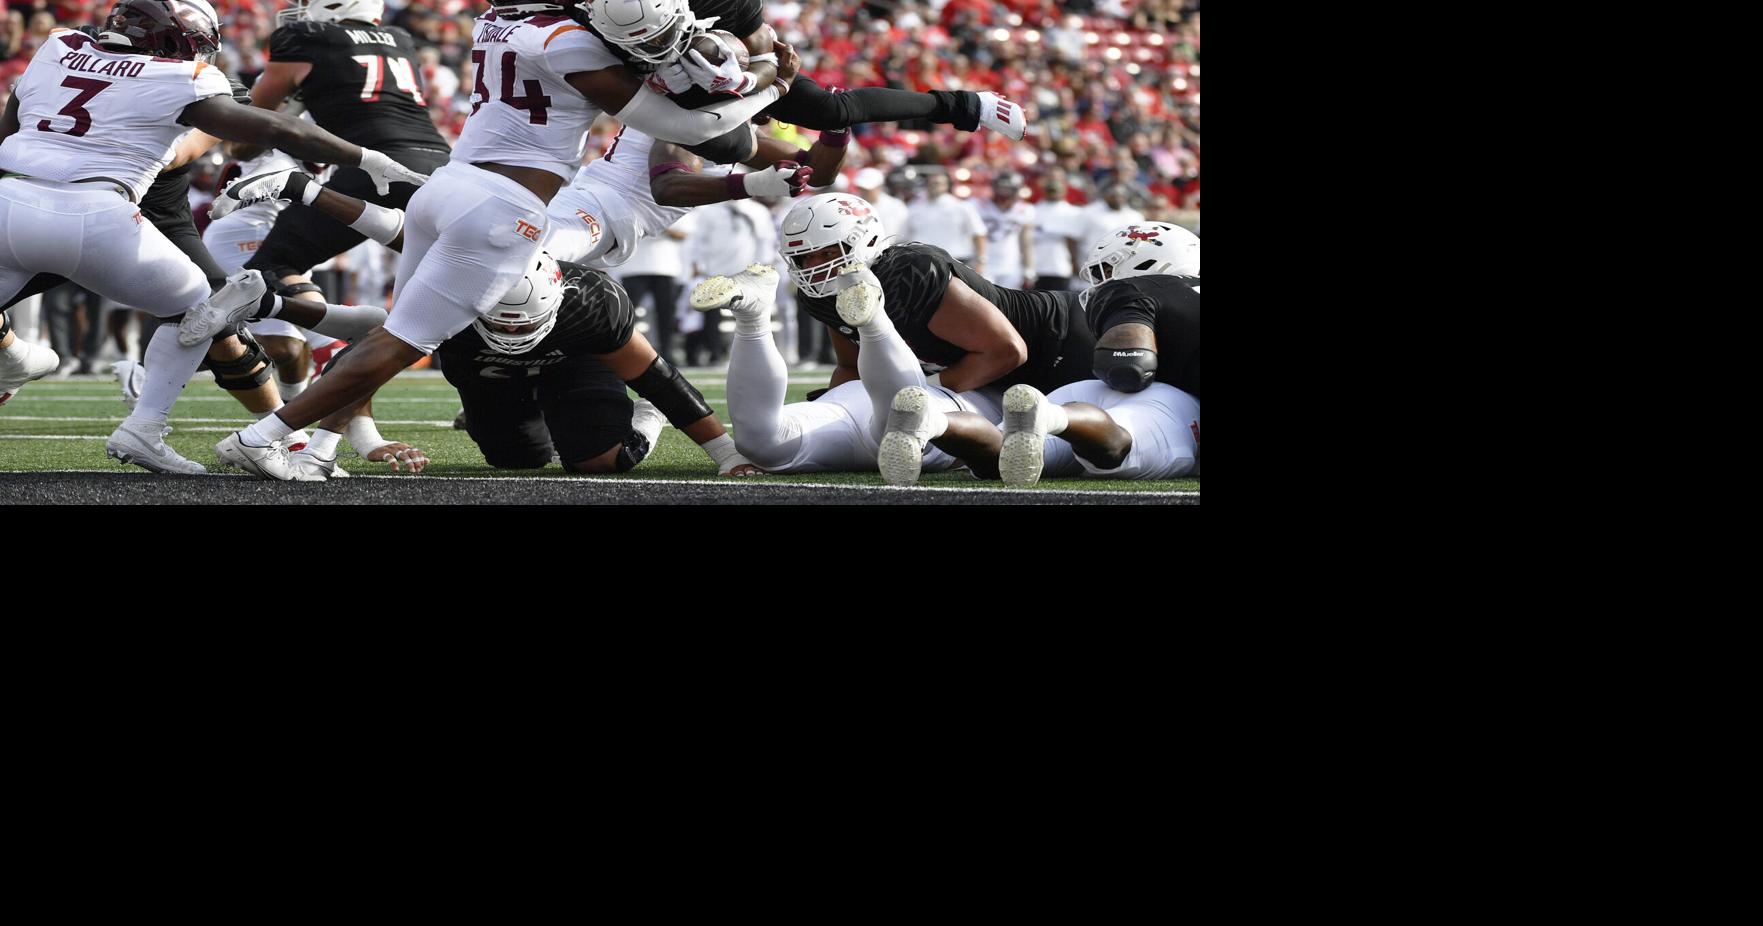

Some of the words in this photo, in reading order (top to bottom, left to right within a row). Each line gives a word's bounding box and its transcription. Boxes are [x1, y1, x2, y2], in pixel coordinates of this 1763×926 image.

[60, 52, 146, 77] POLLARD
[351, 55, 426, 106] 74
[470, 50, 552, 125] 34
[37, 75, 113, 137] 3
